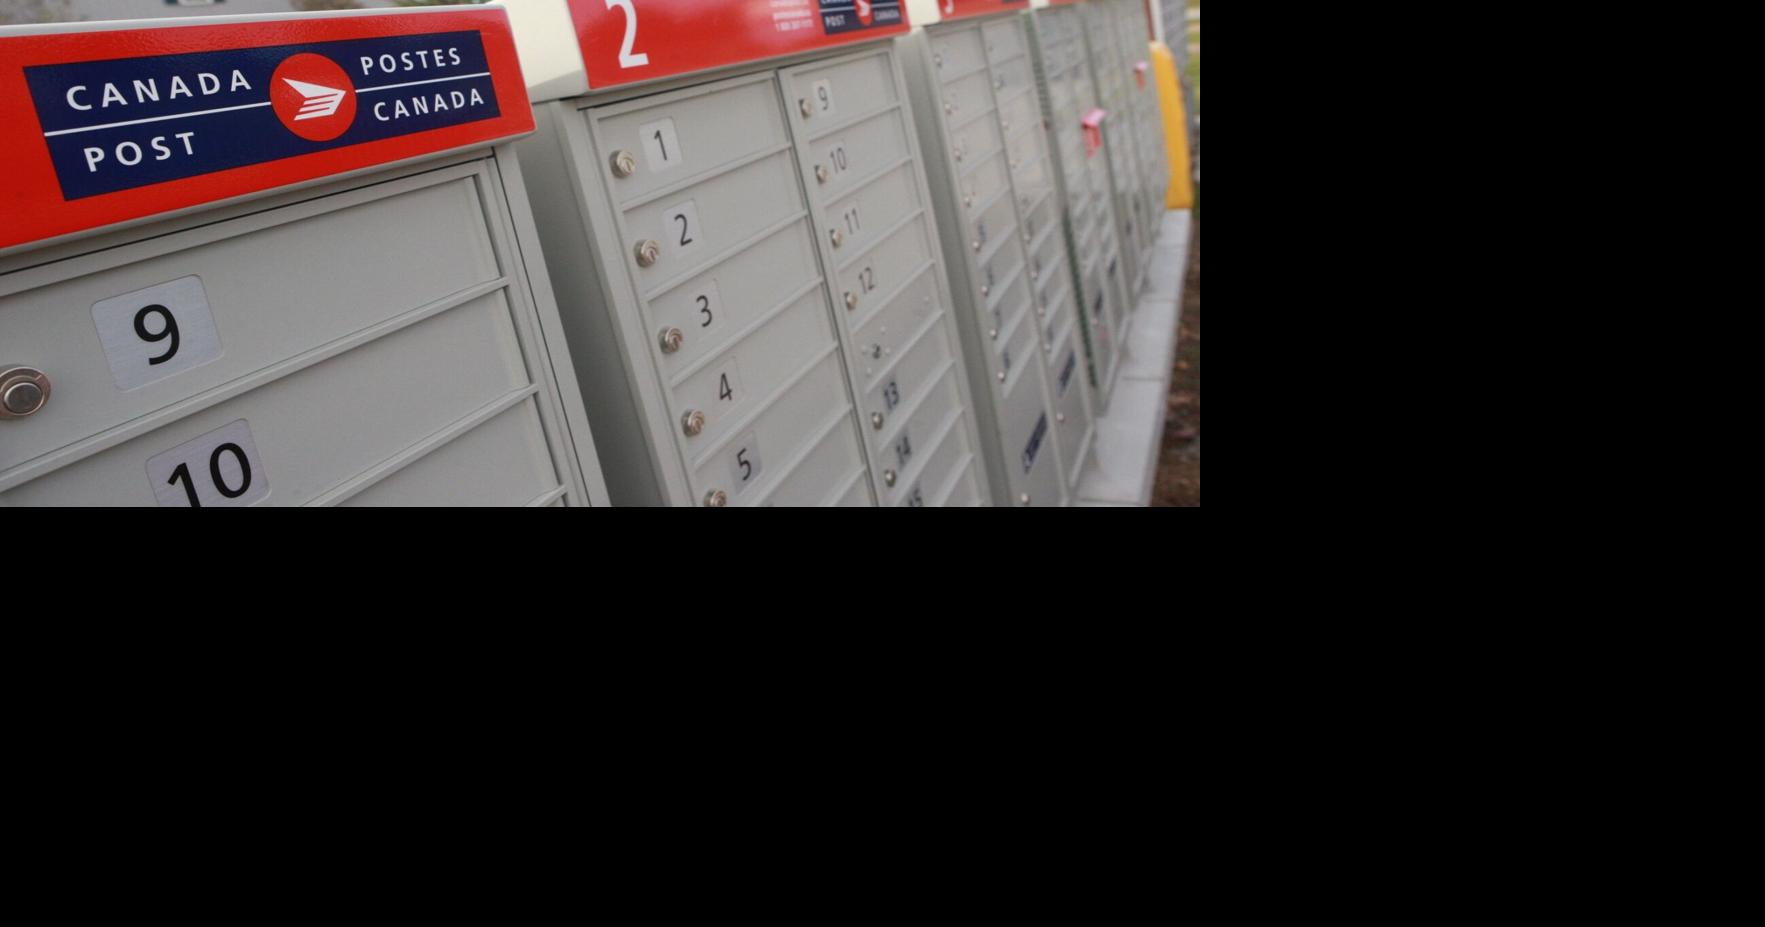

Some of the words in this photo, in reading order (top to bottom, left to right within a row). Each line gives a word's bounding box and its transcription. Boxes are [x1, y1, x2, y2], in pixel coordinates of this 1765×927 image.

[606, 0, 649, 69] 2
[360, 47, 461, 76] POSTES
[66, 69, 252, 111] CANADA
[374, 88, 484, 122] CANADA
[818, 86, 829, 111] 9
[83, 131, 196, 172] POST
[654, 129, 667, 161] 1
[830, 148, 847, 173] 10
[674, 214, 692, 246] 2
[845, 208, 860, 234] 11
[858, 267, 875, 294] 12
[696, 295, 712, 327] 3
[133, 303, 180, 366] 9
[718, 373, 732, 401] 4
[167, 442, 251, 507] 10
[737, 448, 752, 481] 5
